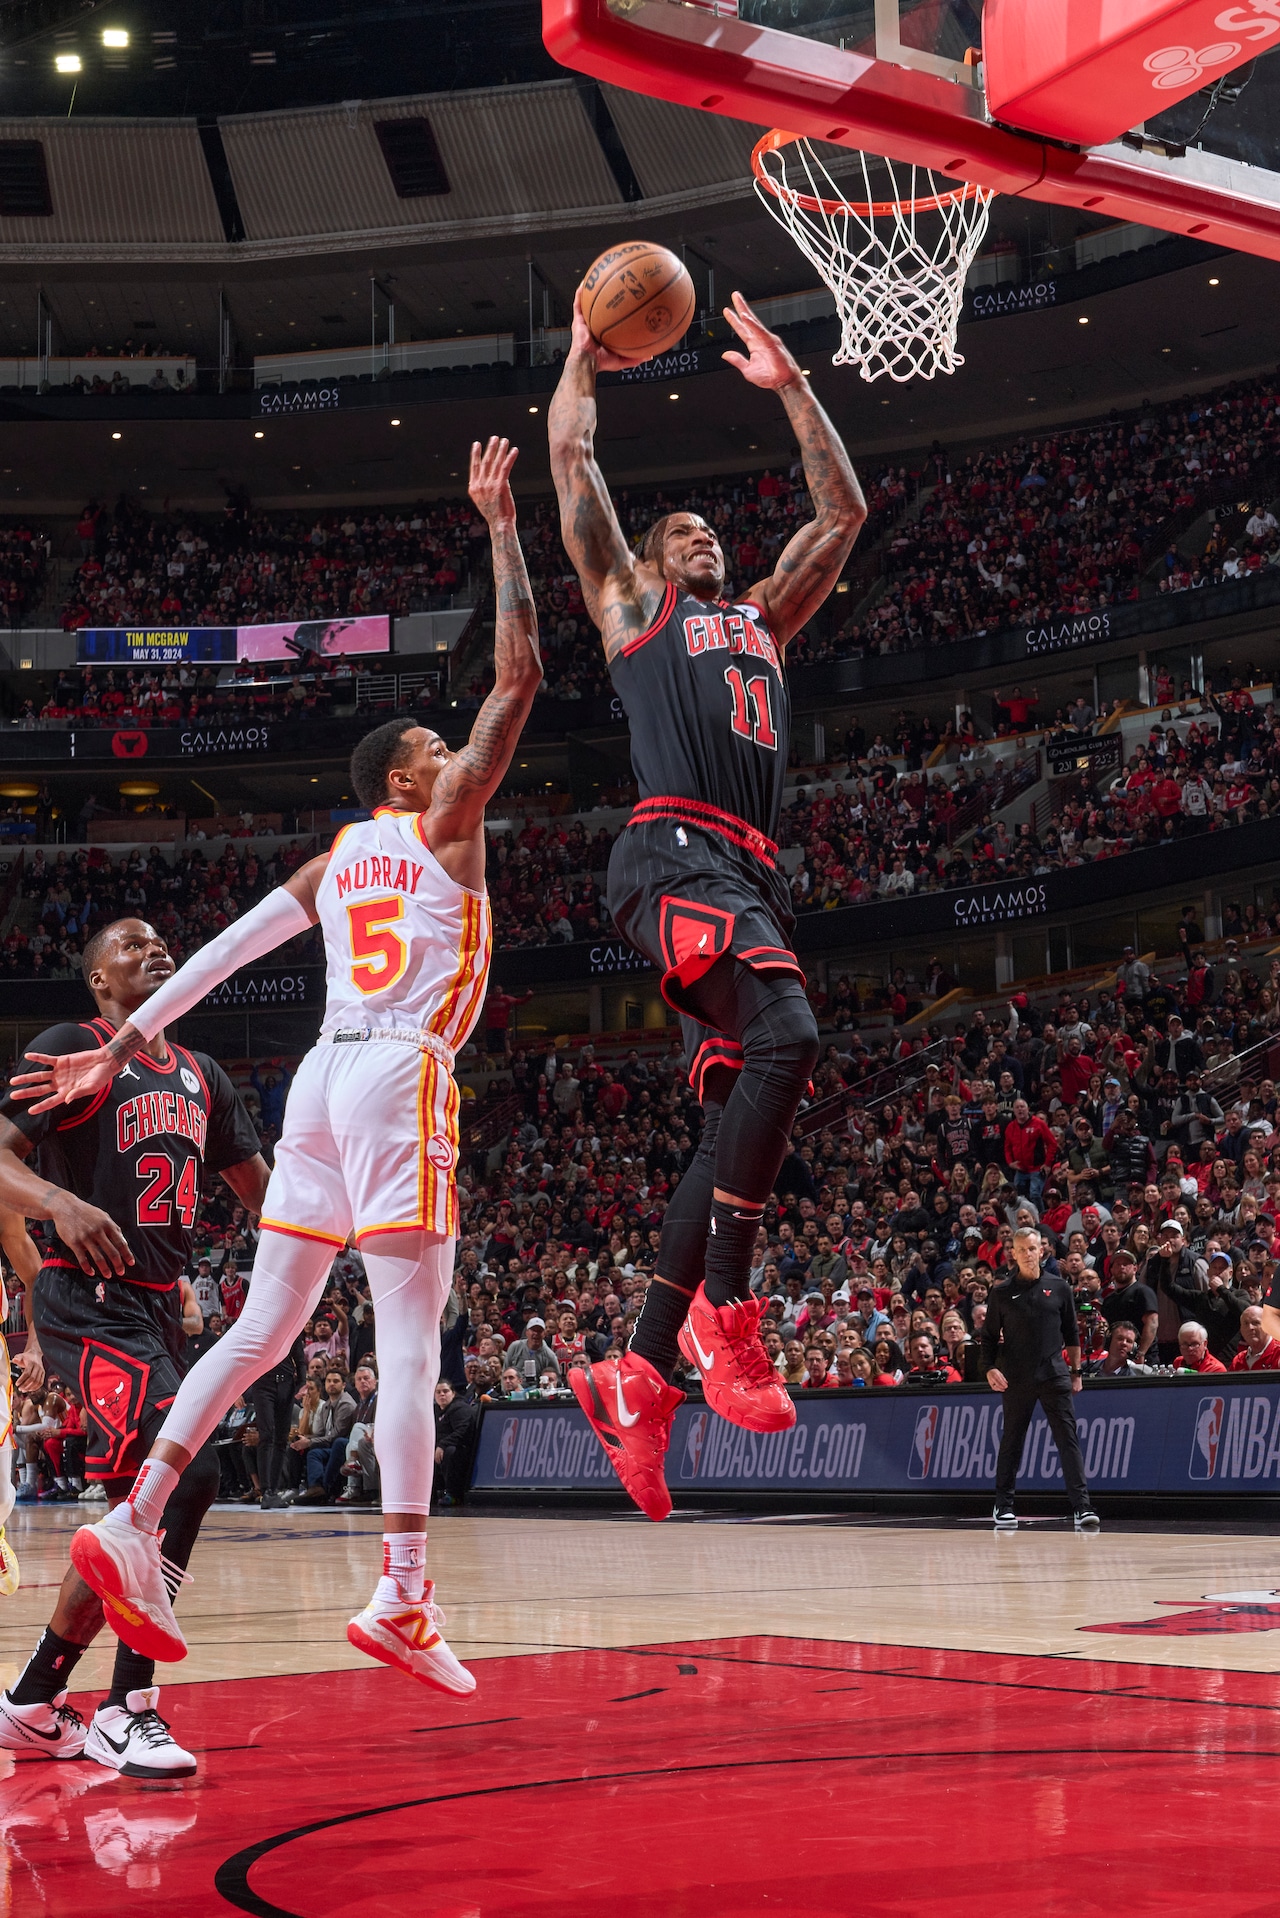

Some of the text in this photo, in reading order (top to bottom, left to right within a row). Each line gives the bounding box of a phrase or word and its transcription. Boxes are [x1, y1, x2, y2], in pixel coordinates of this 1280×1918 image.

[973, 281, 1056, 309] CALAMOS
[974, 294, 1056, 316] INVESTMENTS
[621, 364, 698, 380] INVESTMENTS
[260, 388, 339, 407] CALAMOS
[261, 401, 339, 413] INVESTMENTS
[126, 632, 189, 647] TIM MCGRAW
[1025, 613, 1110, 645] CALAMOS
[1026, 629, 1110, 653] INVESTMENTS
[132, 648, 182, 661] MAY 31, 2024
[724, 665, 778, 751] 11
[180, 728, 268, 746] CALAMOS
[181, 741, 268, 753] INVESTMENTS
[1058, 760, 1073, 773] 231
[336, 855, 424, 899] MURRAY
[954, 884, 1046, 916] CALAMOS
[955, 903, 1047, 926] INVESTMENTS
[346, 894, 407, 996] 5
[208, 975, 305, 997] ALAMOS
[204, 992, 305, 1005] INVESTMENTS
[951, 1139, 969, 1156] 23
[136, 1152, 199, 1229] 24
